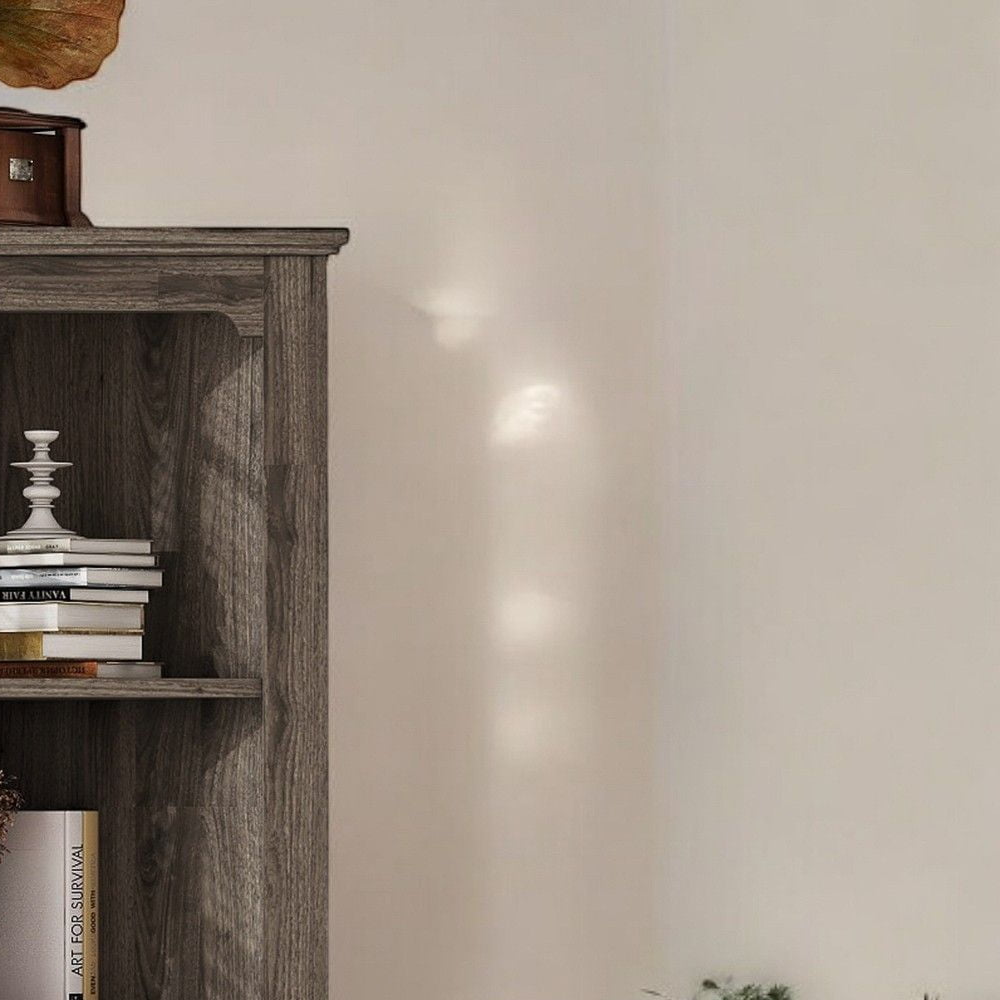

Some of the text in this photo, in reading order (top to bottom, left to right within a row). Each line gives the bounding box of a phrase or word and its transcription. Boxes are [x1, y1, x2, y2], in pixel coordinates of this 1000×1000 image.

[1, 591, 26, 600] FAIR
[29, 590, 67, 600] VANITY
[71, 843, 84, 977] ART FOR SURVIVAL
